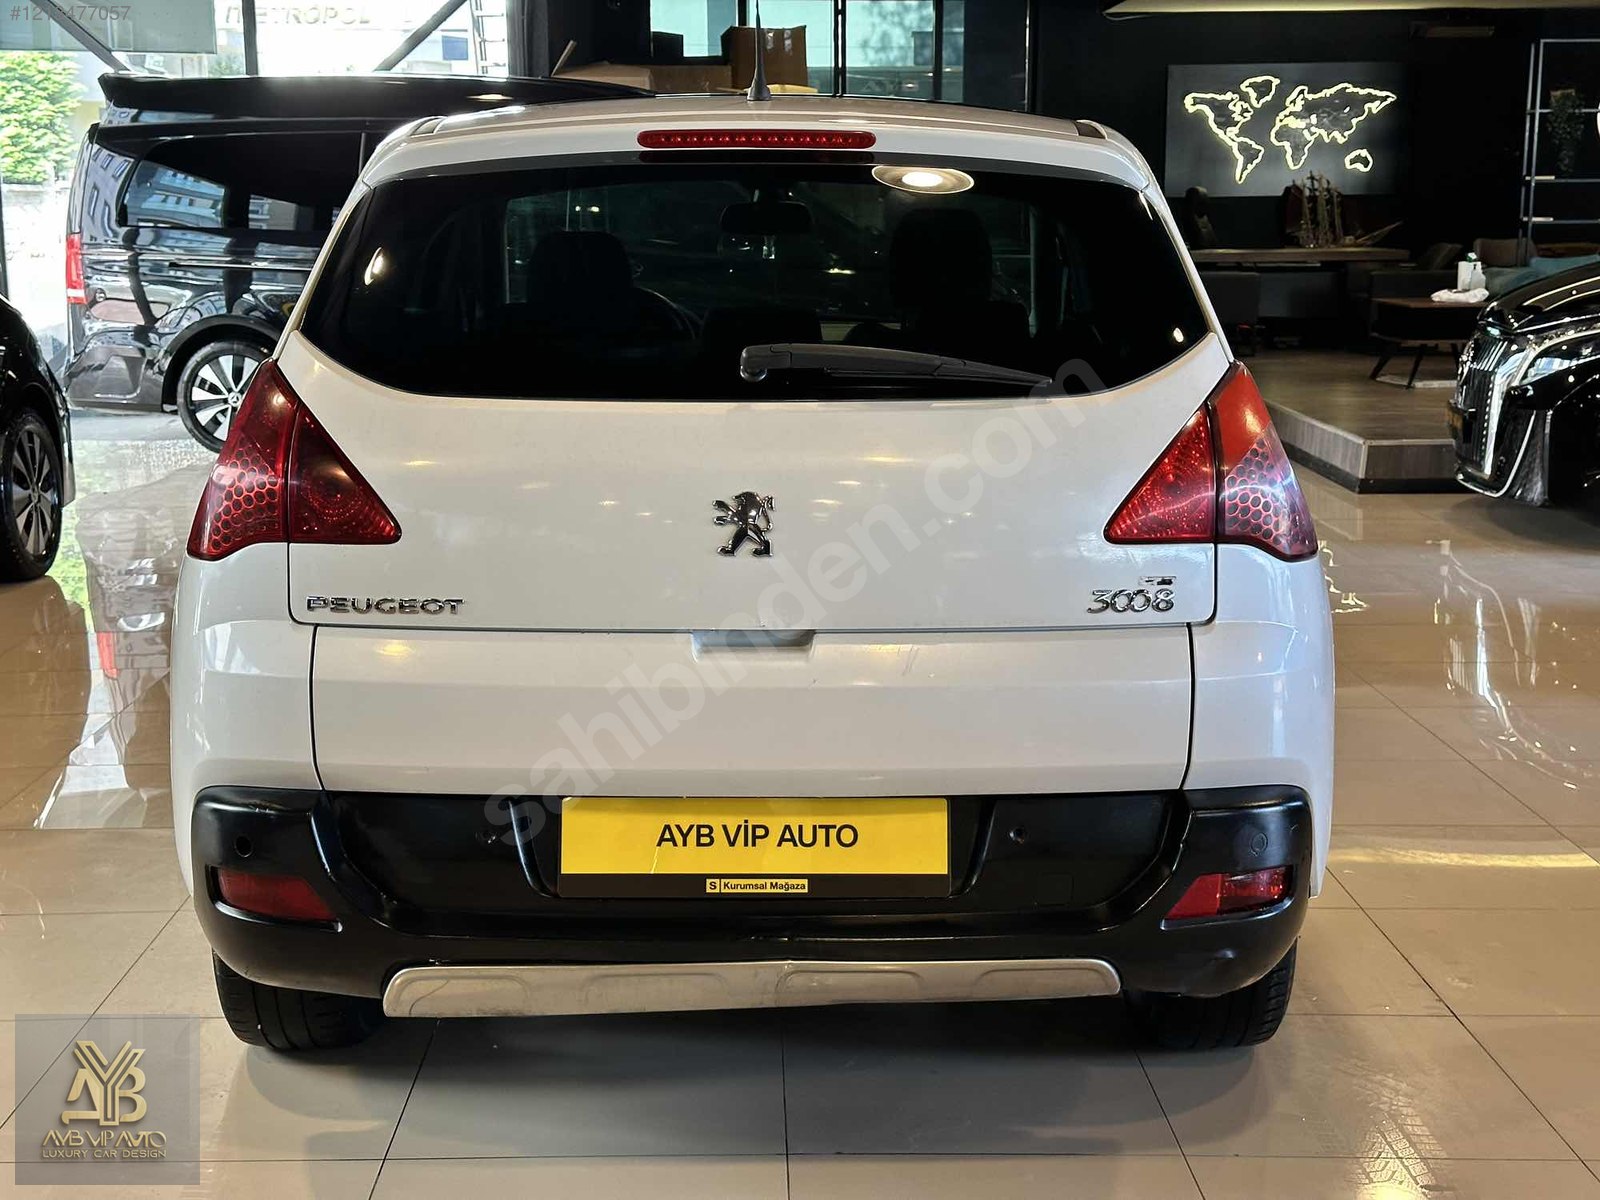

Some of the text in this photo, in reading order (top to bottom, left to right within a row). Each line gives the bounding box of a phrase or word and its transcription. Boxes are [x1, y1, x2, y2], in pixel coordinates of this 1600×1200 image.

[306, 595, 464, 616] PEUGEOT
[1086, 588, 1176, 614] 3008
[656, 824, 716, 848] AYB
[776, 824, 859, 848] AUTO
[723, 880, 768, 891] Kurumsal
[769, 881, 806, 893] Mağaza
